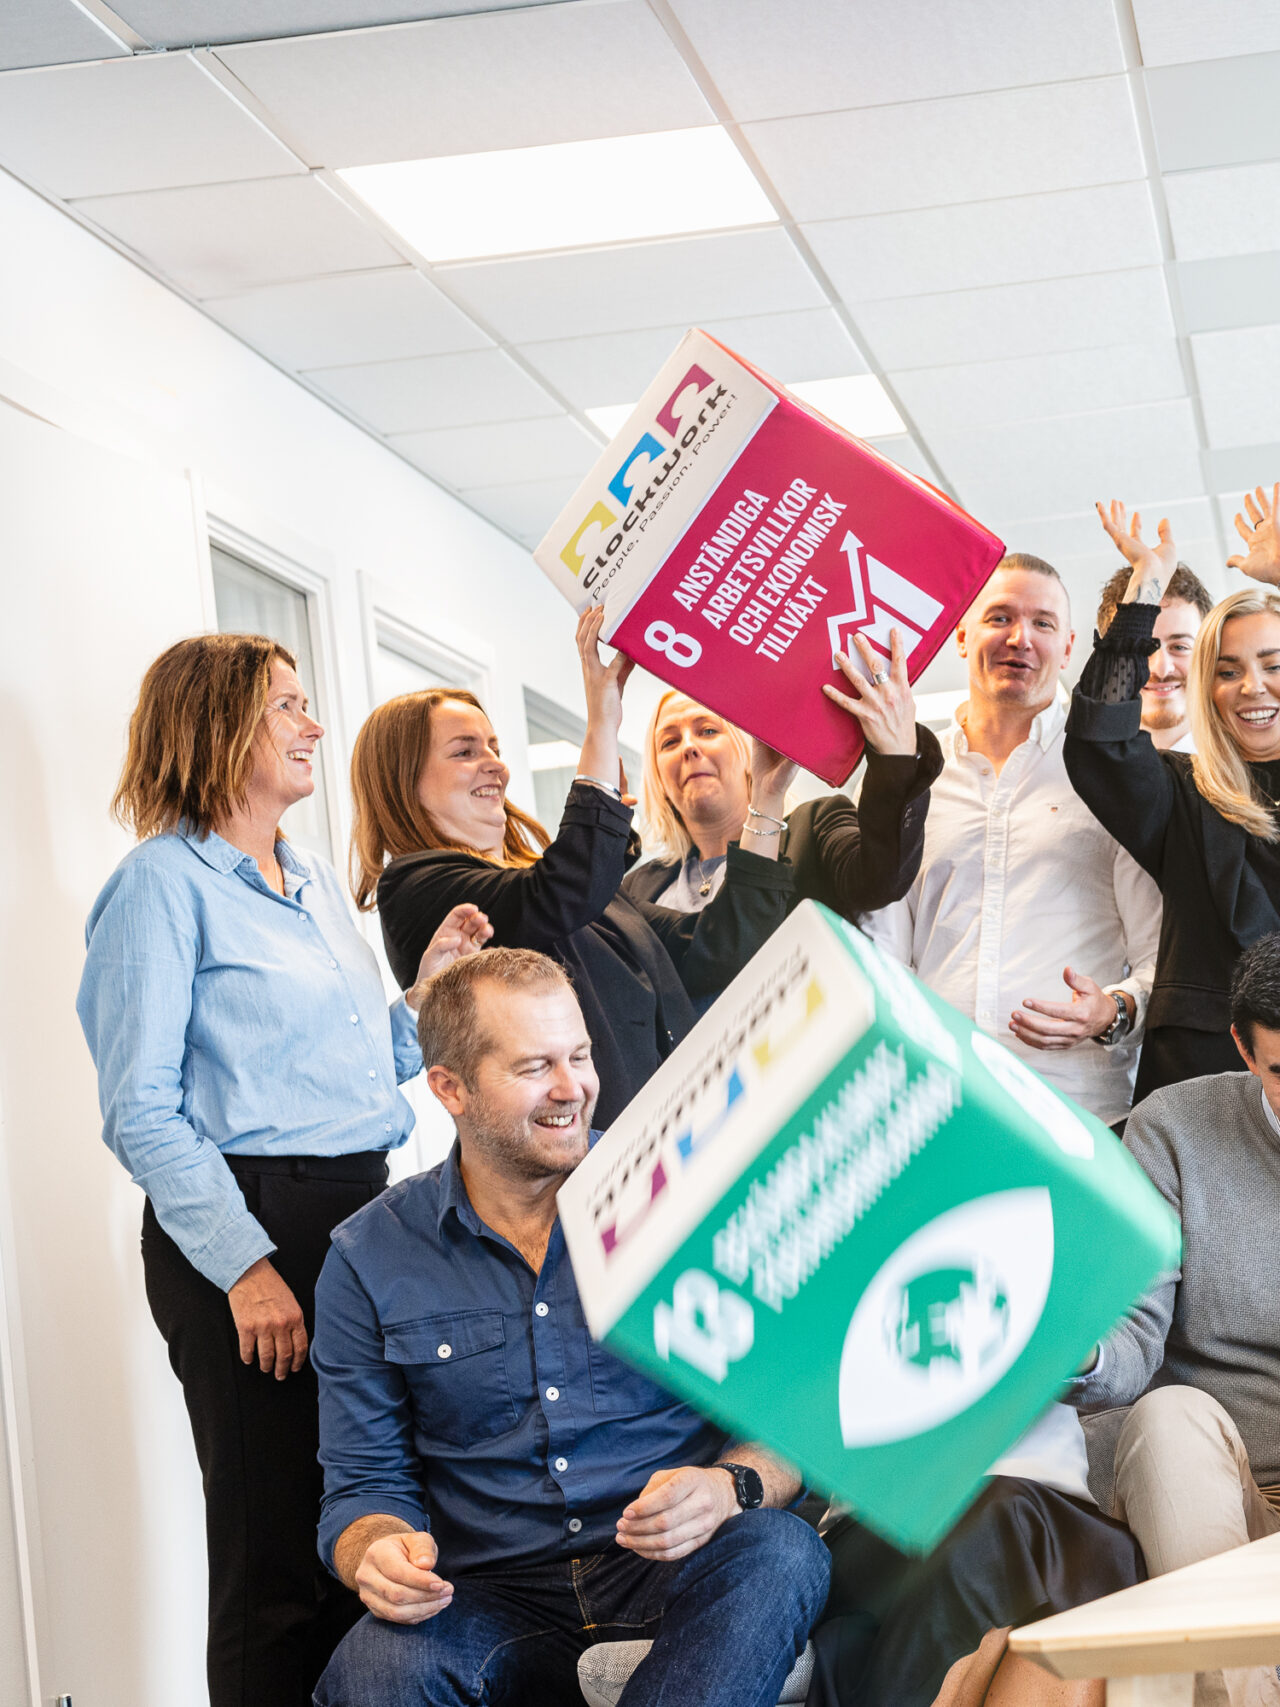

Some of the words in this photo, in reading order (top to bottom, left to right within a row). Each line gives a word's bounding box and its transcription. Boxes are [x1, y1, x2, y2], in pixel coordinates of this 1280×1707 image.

[592, 538, 640, 601] People.
[638, 462, 693, 533] Passion.
[691, 393, 738, 456] Power!
[672, 489, 770, 612] ANSTÄNDIGA
[701, 478, 818, 630] ARBETSVILLKOR
[728, 599, 773, 646] OCH
[755, 492, 847, 608] EKONOMISK
[755, 574, 829, 663] TILLVÄXT
[643, 620, 703, 668] 8
